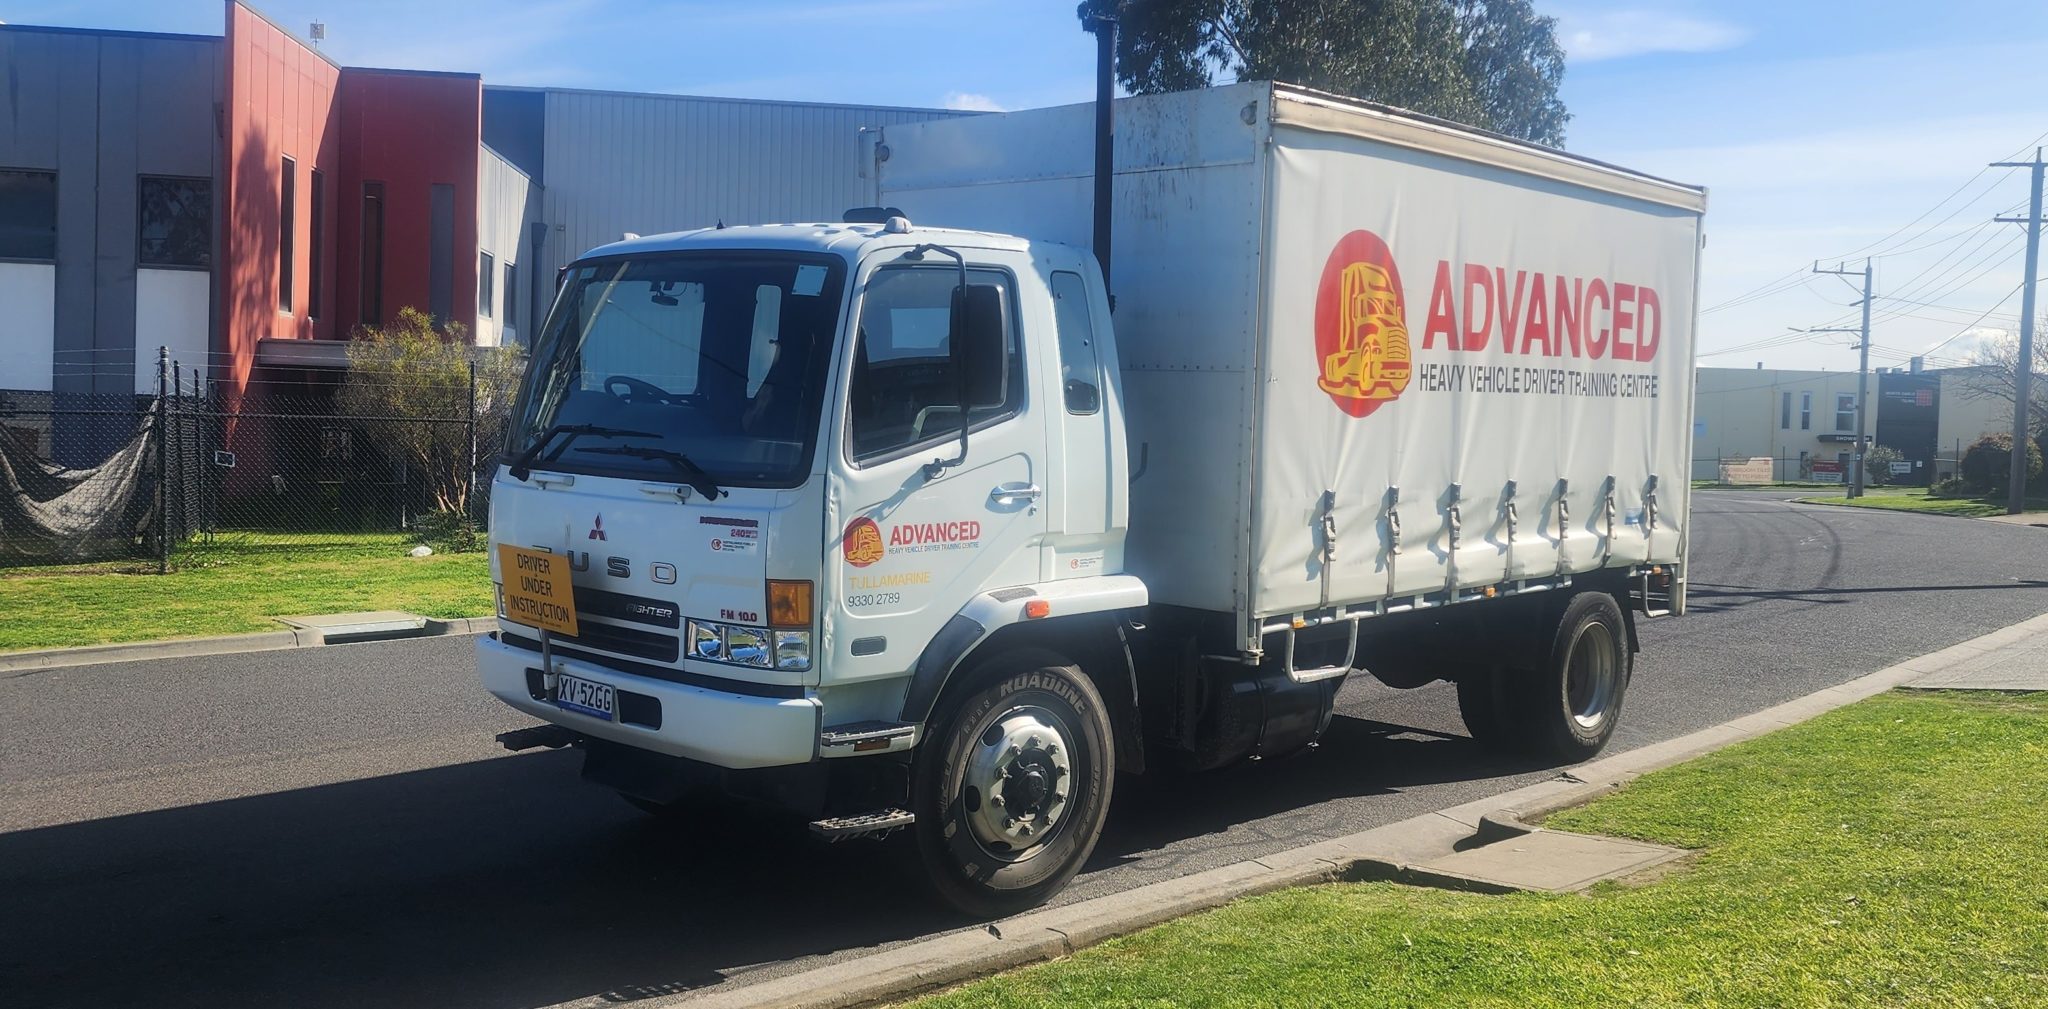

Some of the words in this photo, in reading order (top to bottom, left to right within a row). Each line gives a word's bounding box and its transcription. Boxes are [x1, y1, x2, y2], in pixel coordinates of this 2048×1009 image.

[1422, 260, 1661, 363] ADVANCED
[1420, 363, 1465, 392] HEAVY
[1469, 365, 1520, 393] VEHICLE
[1524, 367, 1565, 394] DRIVER
[1568, 370, 1617, 397] TRAINING
[1620, 374, 1658, 398] CENTRE
[731, 529, 746, 538] 240
[890, 521, 980, 546] ADVANCED
[889, 546, 904, 555] HEAVY
[905, 545, 923, 553] VEHICLE
[924, 544, 940, 552] DRIVER
[941, 543, 961, 551] TRAINING
[962, 541, 979, 549] CENTRE
[517, 553, 551, 574] DRIVER
[532, 545, 677, 584] USO
[521, 576, 552, 597] UNDER
[849, 571, 931, 591] TULLAMARINE
[510, 594, 570, 623] INSTRUCTION
[625, 602, 673, 618] FIGHTER
[848, 595, 873, 607] 9330
[876, 592, 900, 605] 2789
[720, 609, 734, 620] FM
[738, 611, 757, 622] 10.0
